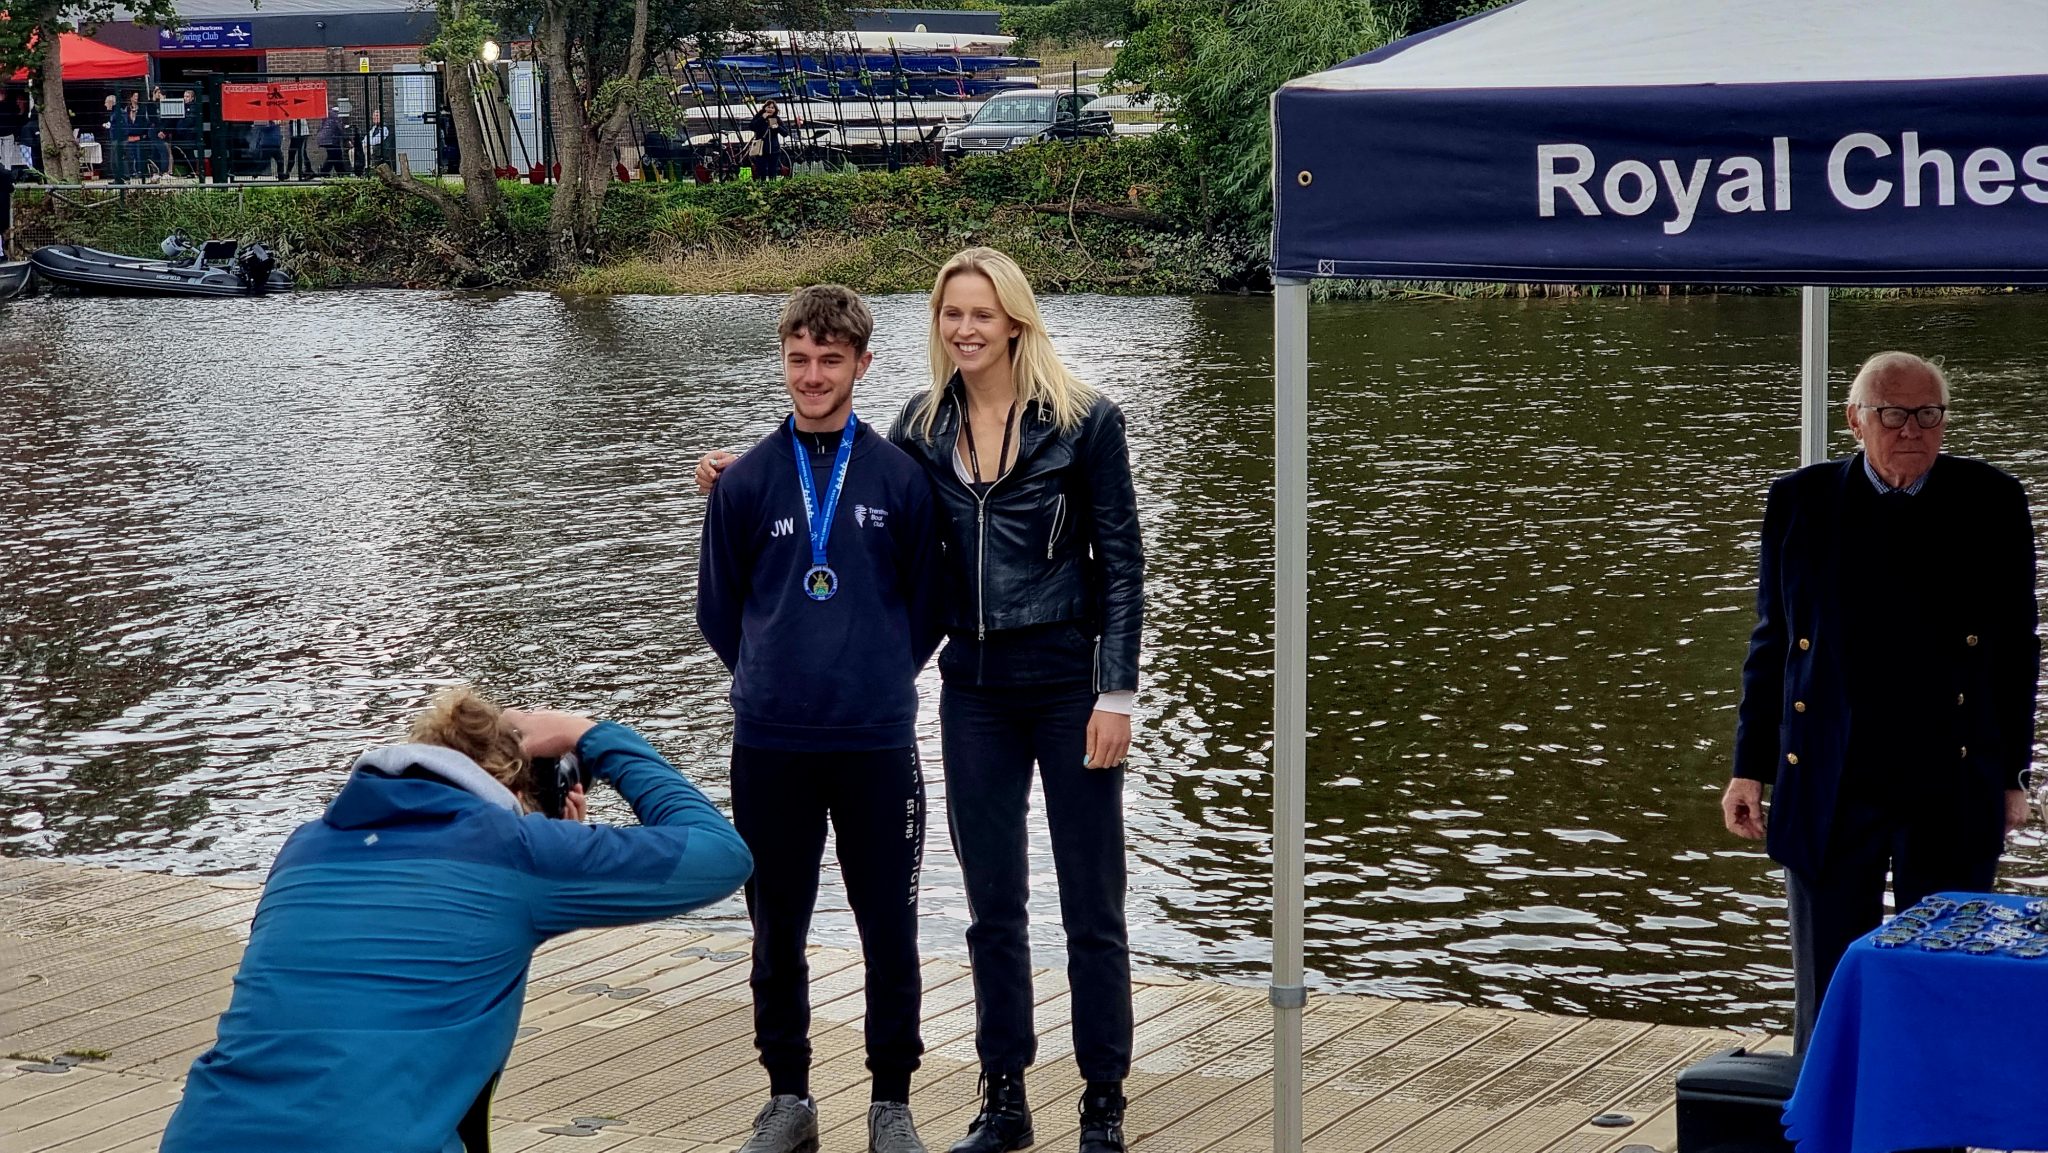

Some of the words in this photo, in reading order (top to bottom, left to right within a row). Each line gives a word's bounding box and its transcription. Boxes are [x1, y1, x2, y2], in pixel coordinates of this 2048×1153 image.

[202, 31, 219, 40] Club
[1537, 135, 1791, 235] Royal
[771, 517, 794, 538] JW
[873, 520, 885, 528] Club
[905, 819, 914, 839] 1985
